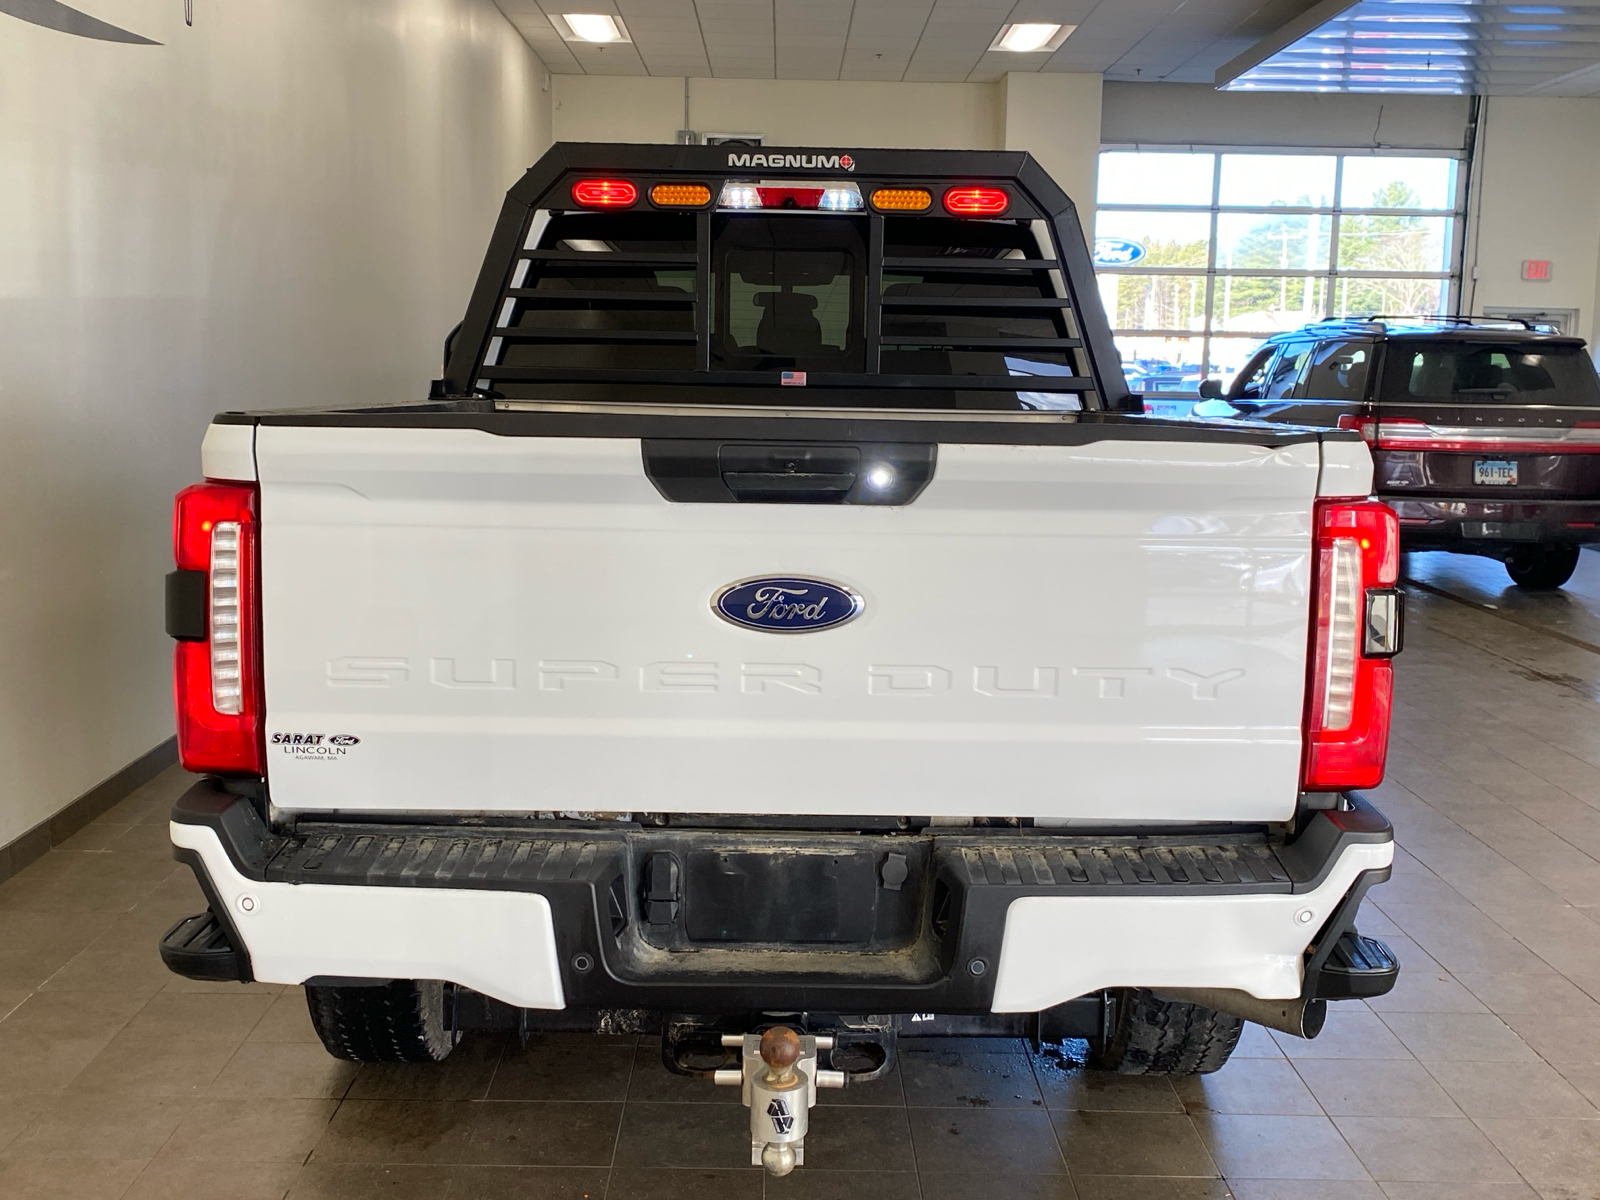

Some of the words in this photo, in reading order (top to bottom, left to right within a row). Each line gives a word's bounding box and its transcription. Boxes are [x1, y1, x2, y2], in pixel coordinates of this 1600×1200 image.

[728, 153, 840, 169] MAGNUM
[1094, 241, 1134, 262] Ford
[1527, 261, 1550, 278] EXIT
[1437, 415, 1562, 423] LINCOLN
[1478, 467, 1513, 478] 961-TEC
[746, 586, 829, 621] Ford
[326, 655, 822, 695] SUPER
[868, 664, 1247, 700] DUTY
[271, 732, 325, 745] SARAT
[332, 735, 357, 745] Ford
[284, 746, 346, 754] LINCOLN
